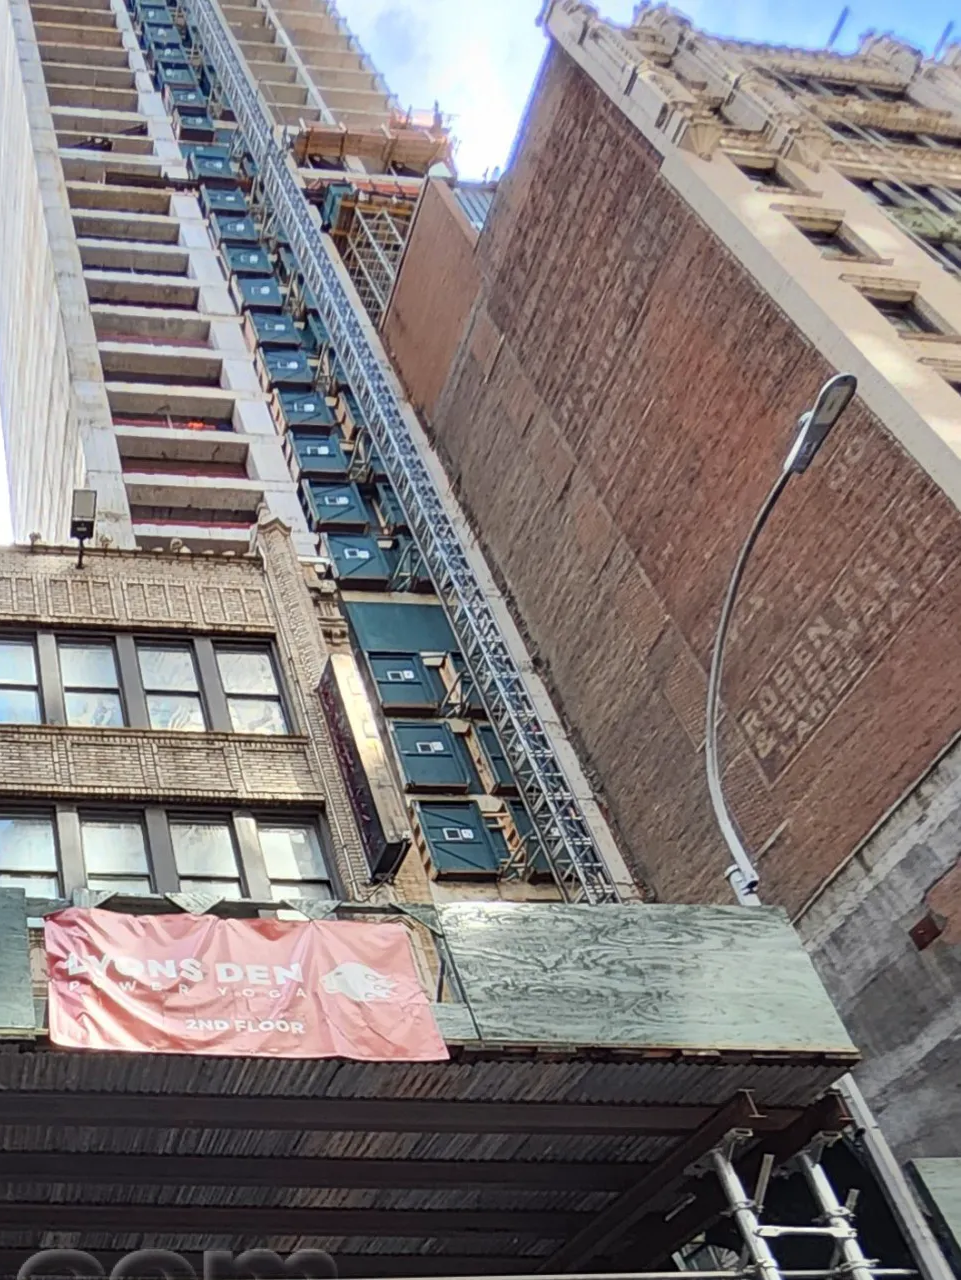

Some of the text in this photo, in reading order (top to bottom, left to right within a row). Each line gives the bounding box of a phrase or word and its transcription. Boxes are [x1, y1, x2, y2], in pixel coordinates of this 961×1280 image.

[65, 952, 303, 985] LYONS DEN
[68, 981, 307, 998] POWER YOGA
[186, 1019, 304, 1034] 2ND FLOOR
